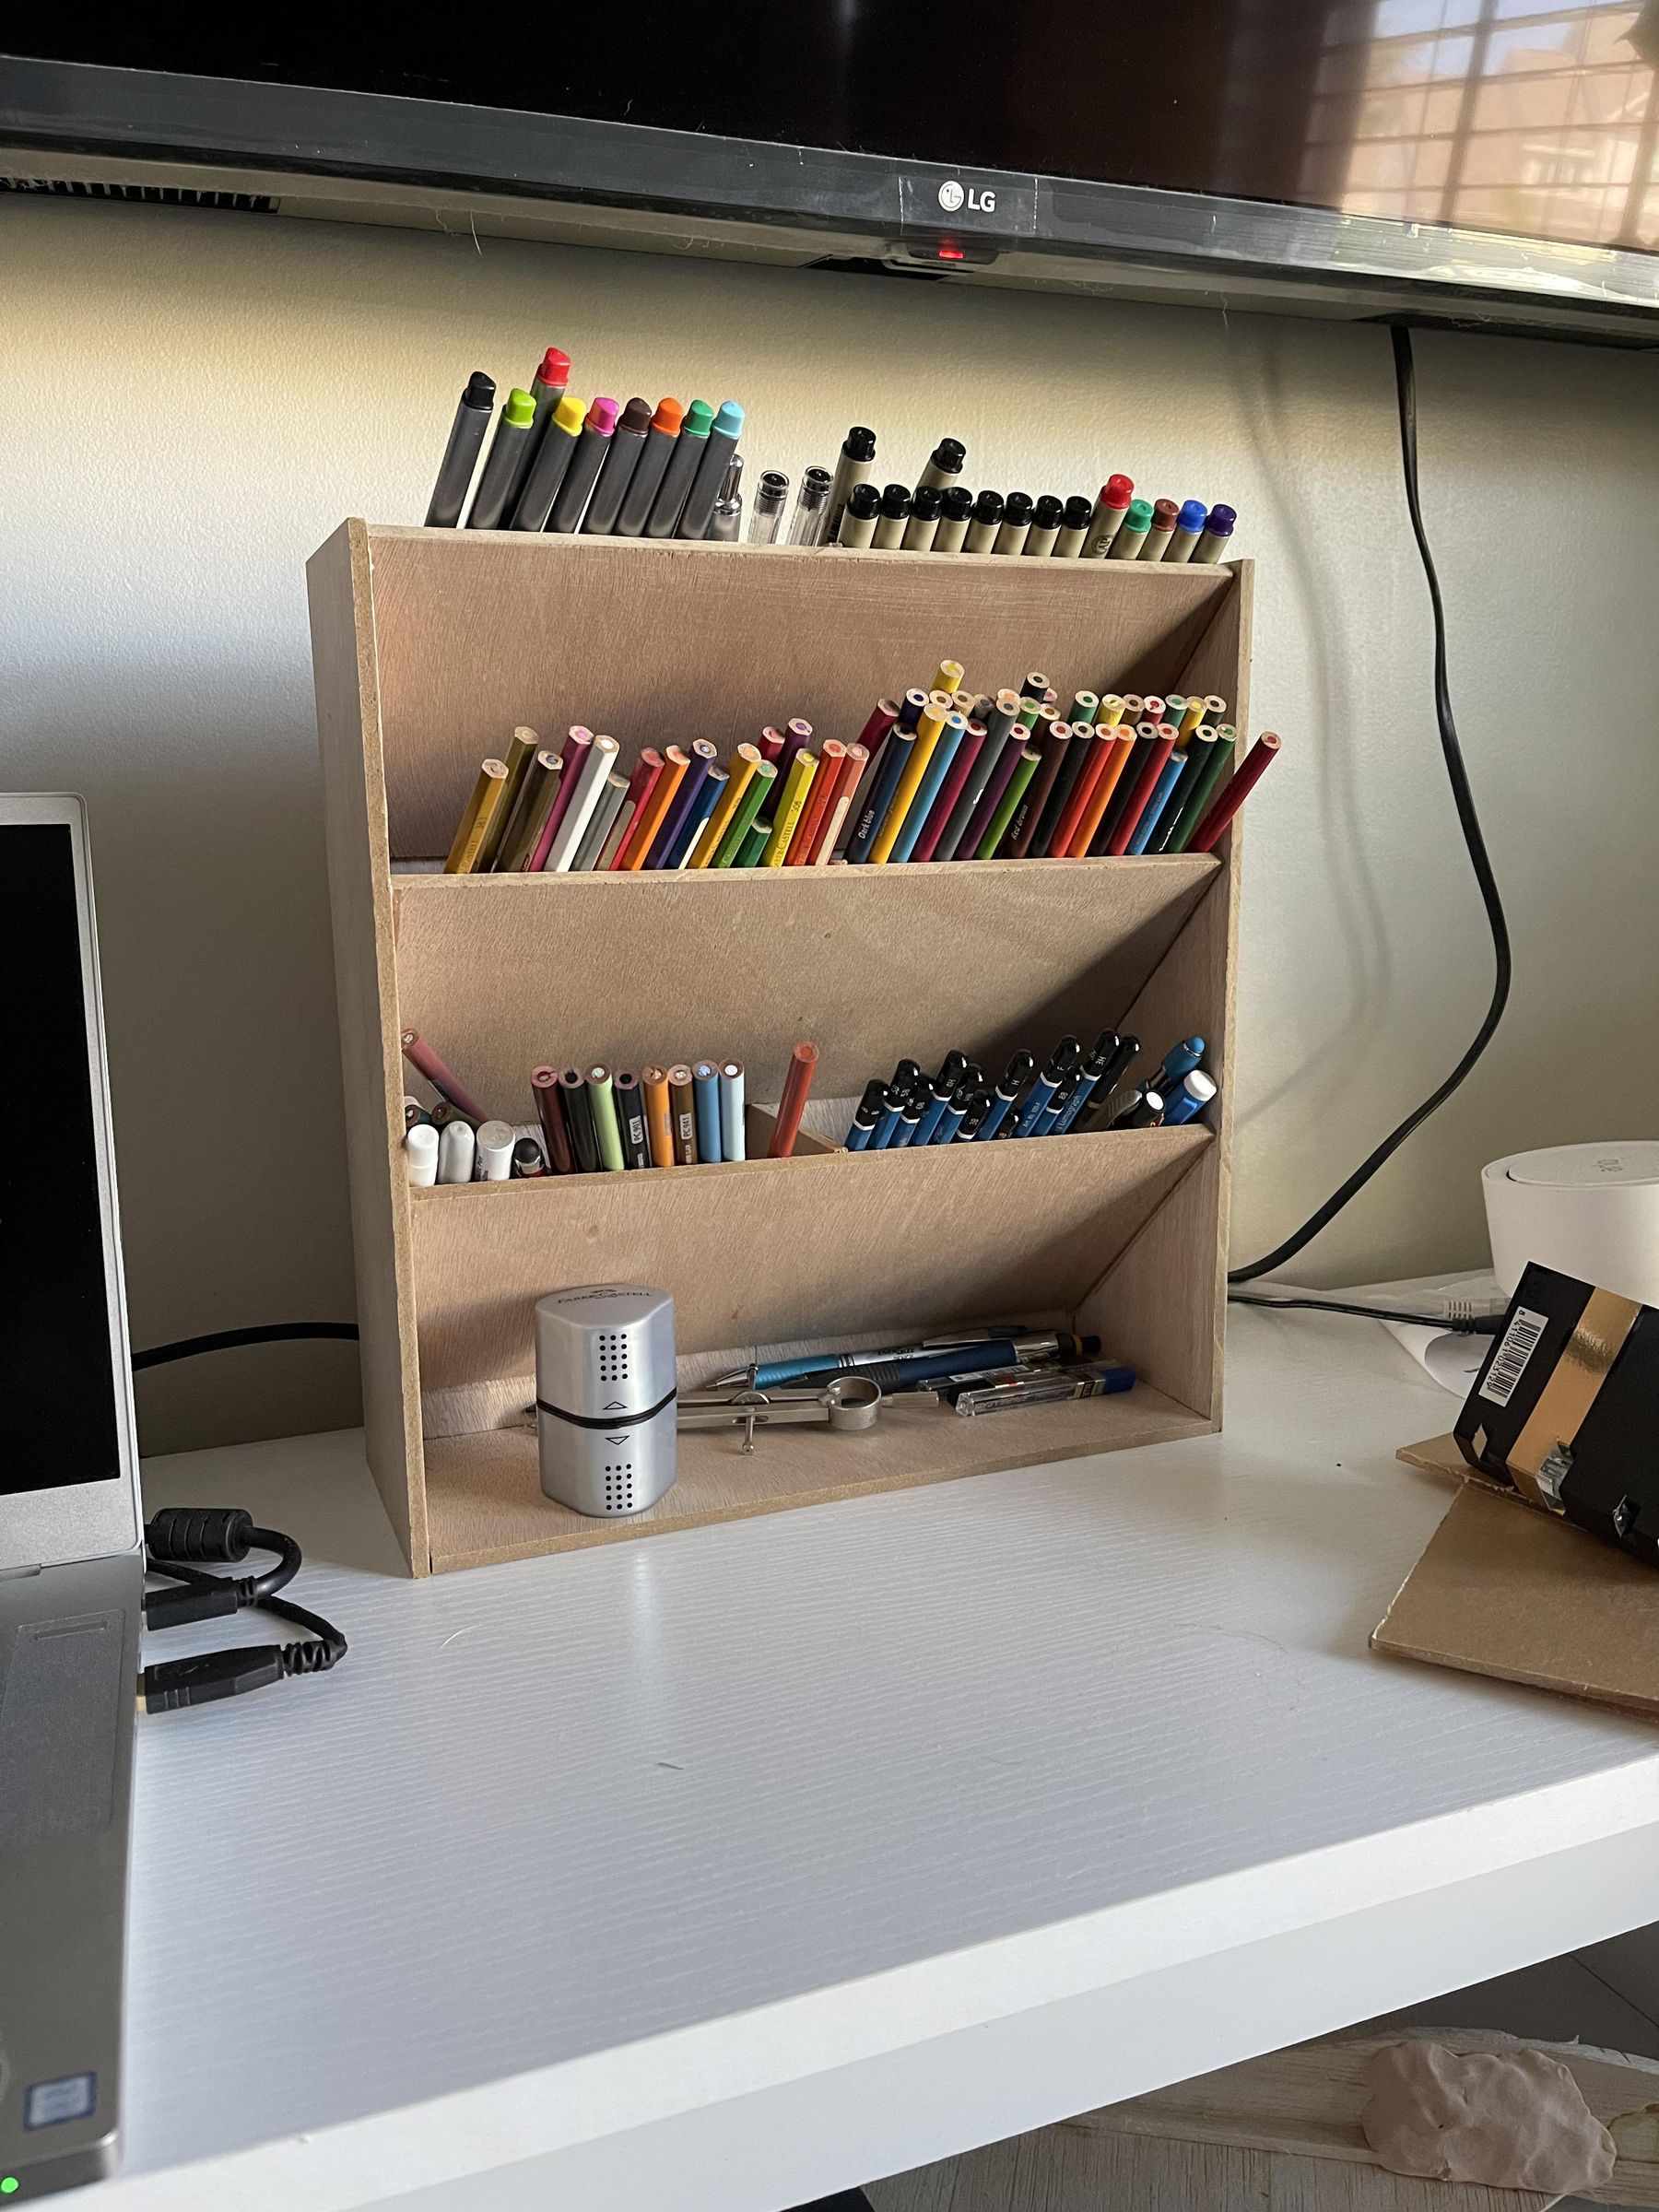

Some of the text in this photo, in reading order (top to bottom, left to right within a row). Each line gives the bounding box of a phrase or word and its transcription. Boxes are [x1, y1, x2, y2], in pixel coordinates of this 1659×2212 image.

[968, 188, 995, 213] LG
[858, 810, 876, 840] Dark blue
[1096, 1055, 1107, 1066] 3H
[1501, 1320, 1522, 1353] 411061
[1486, 1355, 1505, 1389] 023129
